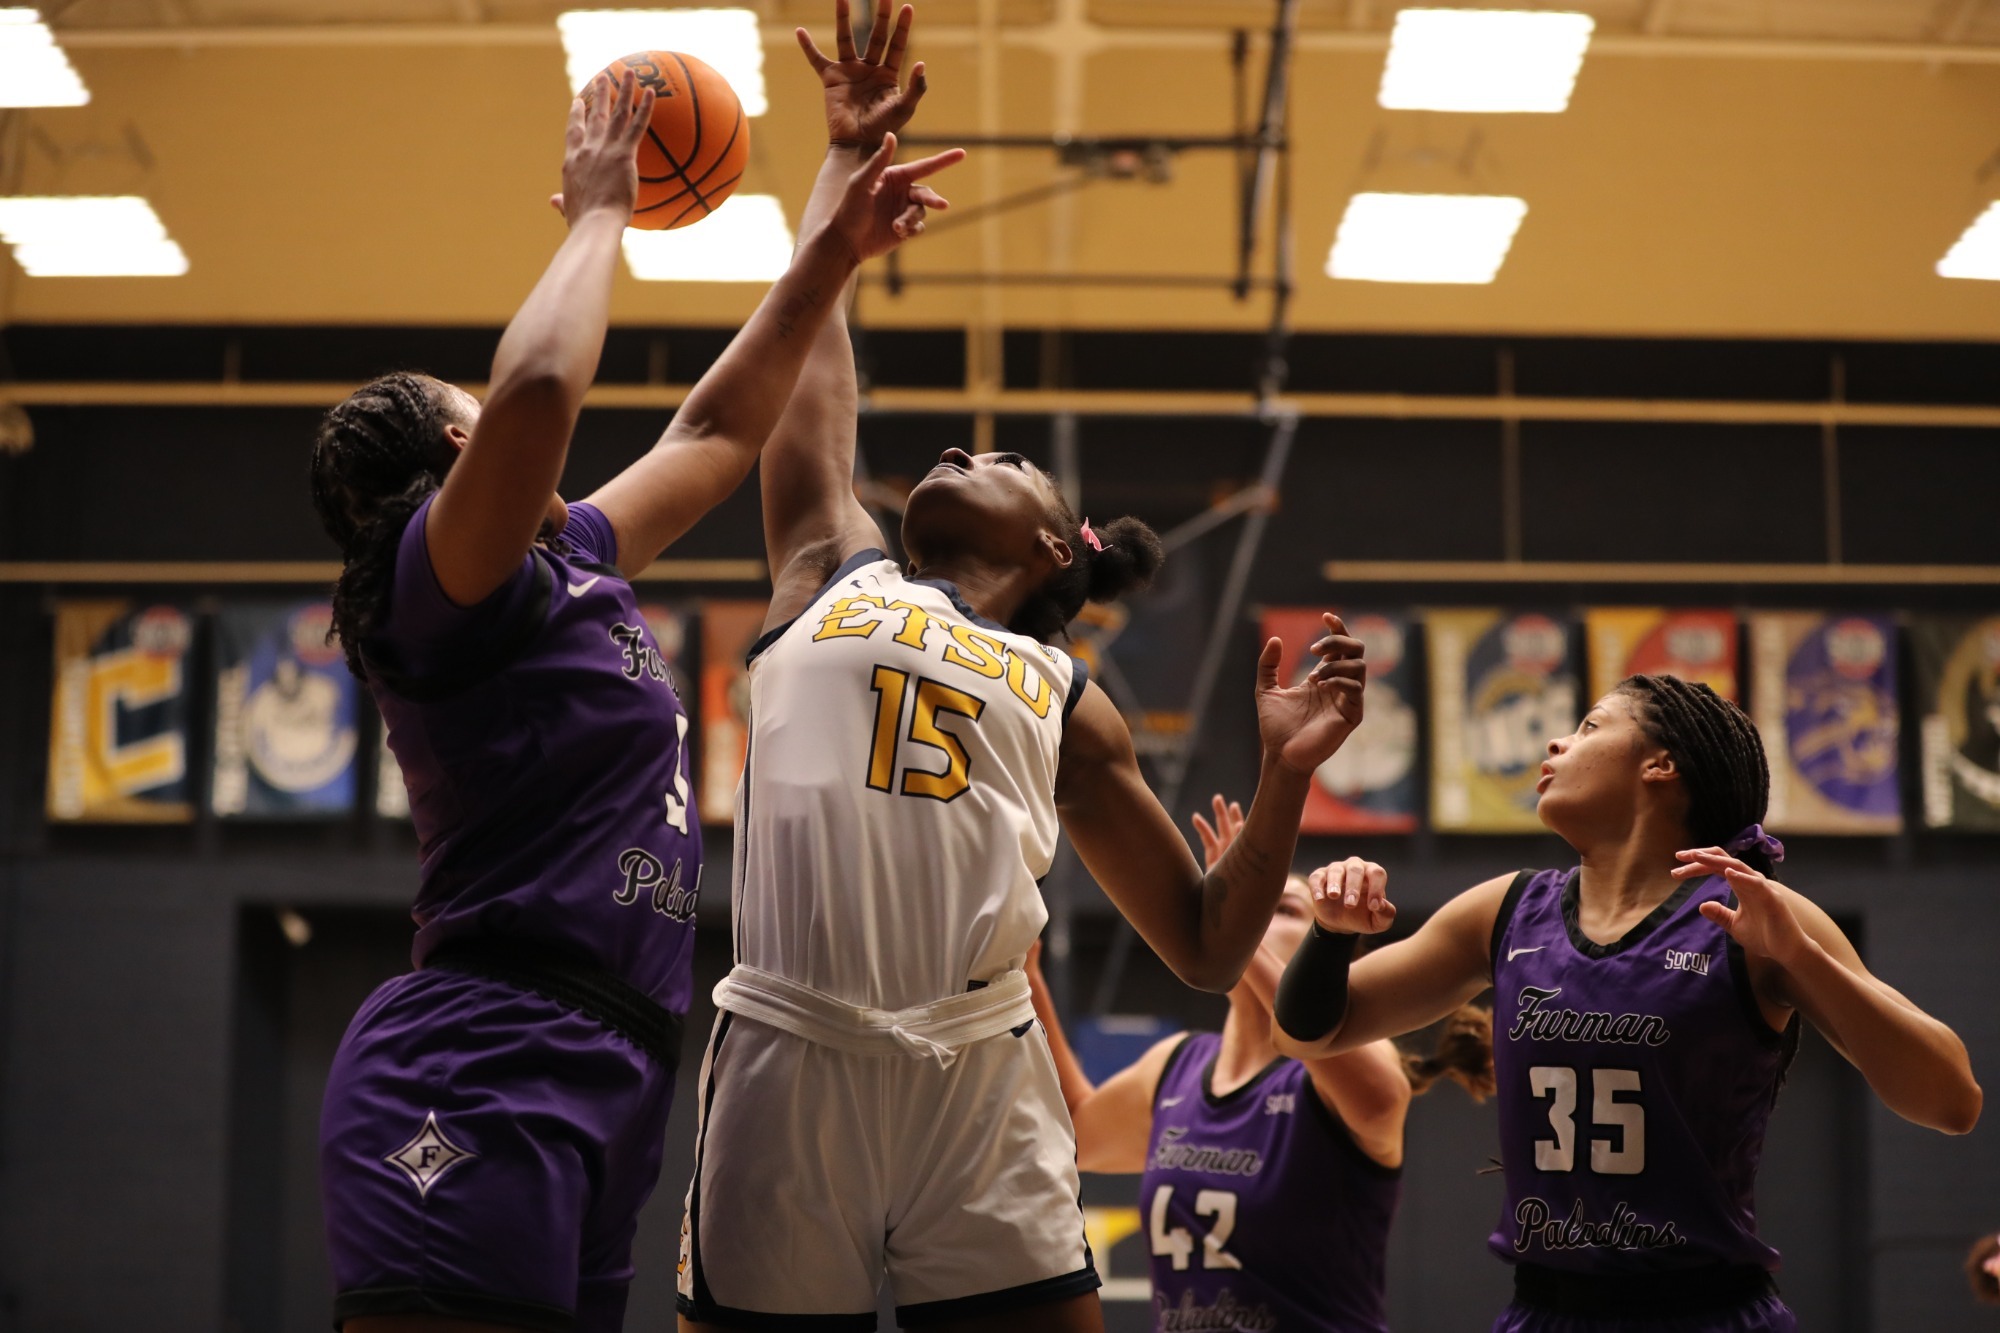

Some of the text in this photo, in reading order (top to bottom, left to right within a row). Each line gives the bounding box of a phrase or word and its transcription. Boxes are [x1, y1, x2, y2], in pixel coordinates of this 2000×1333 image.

[812, 593, 1052, 719] ETSU
[866, 663, 986, 803] 15
[613, 847, 703, 930] Palad
[1509, 986, 1670, 1046] Furman
[417, 1145, 441, 1169] F
[1149, 1126, 1263, 1176] Furman
[1529, 1066, 1645, 1175] 35
[1150, 1185, 1243, 1271] 42
[1514, 1197, 1687, 1252] Paladins
